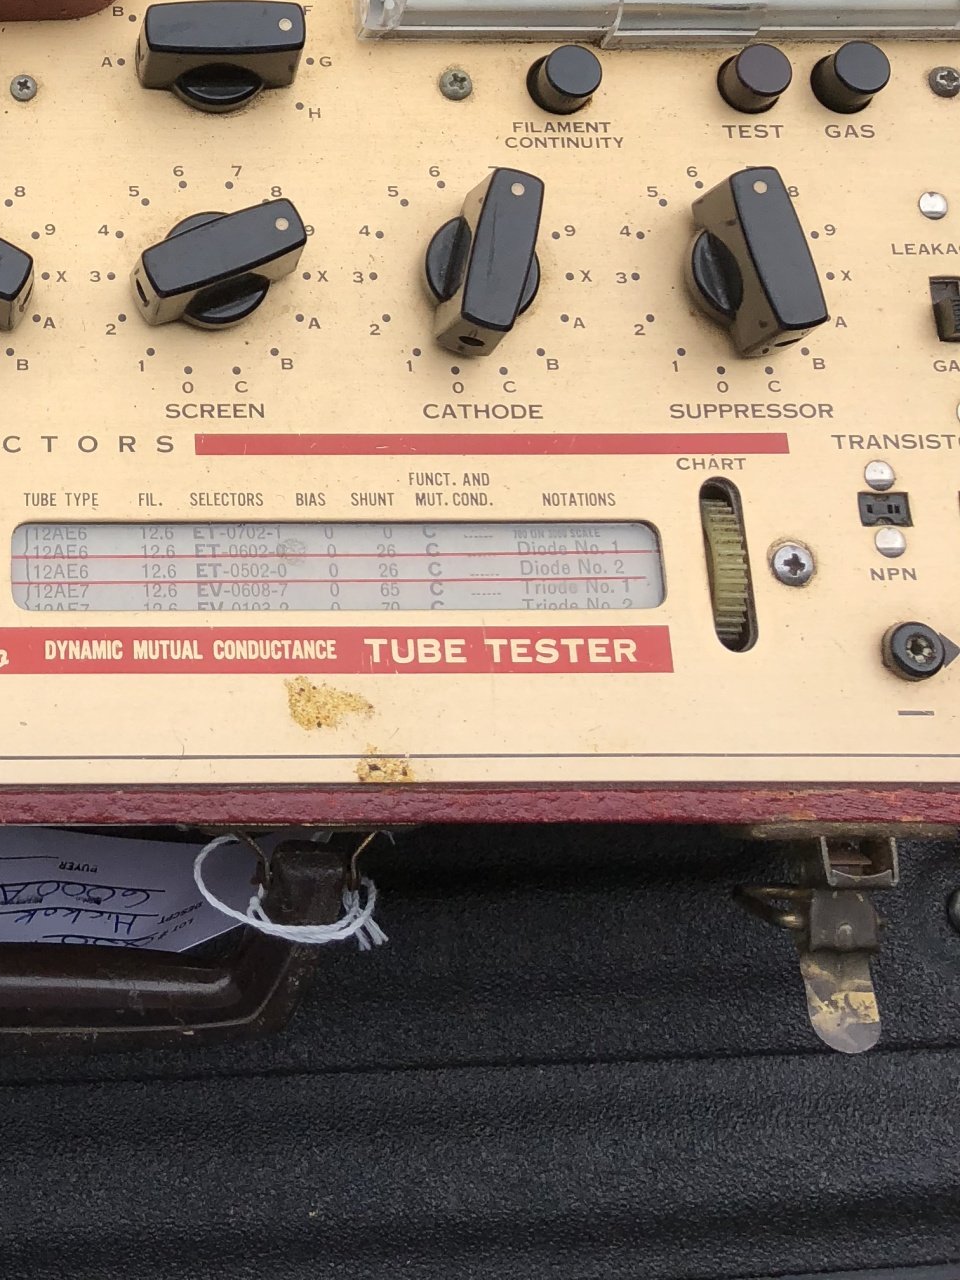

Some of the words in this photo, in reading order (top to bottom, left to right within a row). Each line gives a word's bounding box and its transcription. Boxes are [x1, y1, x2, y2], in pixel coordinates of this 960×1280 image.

[512, 122, 612, 134] FILAMENT
[722, 124, 784, 139] TEST
[824, 124, 876, 140] GAS
[505, 136, 624, 149] CONTINUITY
[891, 243, 960, 256] LEAKA
[165, 403, 265, 420] SCREEN
[422, 403, 544, 420] CATHODE
[670, 403, 834, 420] SUPPRESSOR
[676, 458, 747, 470] CHART
[408, 472, 456, 486] FUNCT.
[462, 472, 490, 486] AND
[24, 492, 57, 507] TUBE
[65, 492, 99, 507] TYPE
[138, 492, 163, 507] FIL.
[190, 492, 264, 507] SELECTORS
[295, 492, 326, 507] BIAS
[350, 492, 395, 507] SHUNT
[415, 492, 448, 507] MUT.
[452, 492, 494, 507] COND.
[542, 492, 616, 507] NOTATIONS
[34, 564, 89, 579] 12AE6
[142, 564, 176, 578] 12.6
[196, 564, 288, 578] ET-0502-0
[378, 563, 398, 578] 26
[520, 560, 571, 576] Diode
[578, 560, 608, 575] No.
[870, 568, 918, 581] NPN
[34, 584, 90, 598] 12AE7
[144, 584, 178, 598] 12.6
[197, 583, 288, 598] EV-0608-7
[380, 583, 400, 597] 65
[523, 580, 578, 595] Triode
[586, 580, 615, 594] No.
[44, 639, 123, 660] DYNAMIC
[133, 639, 203, 660] MUTUAL
[212, 638, 336, 660] CONDUCTANCE
[364, 638, 467, 664] TUBE
[484, 638, 638, 664] TESTER
